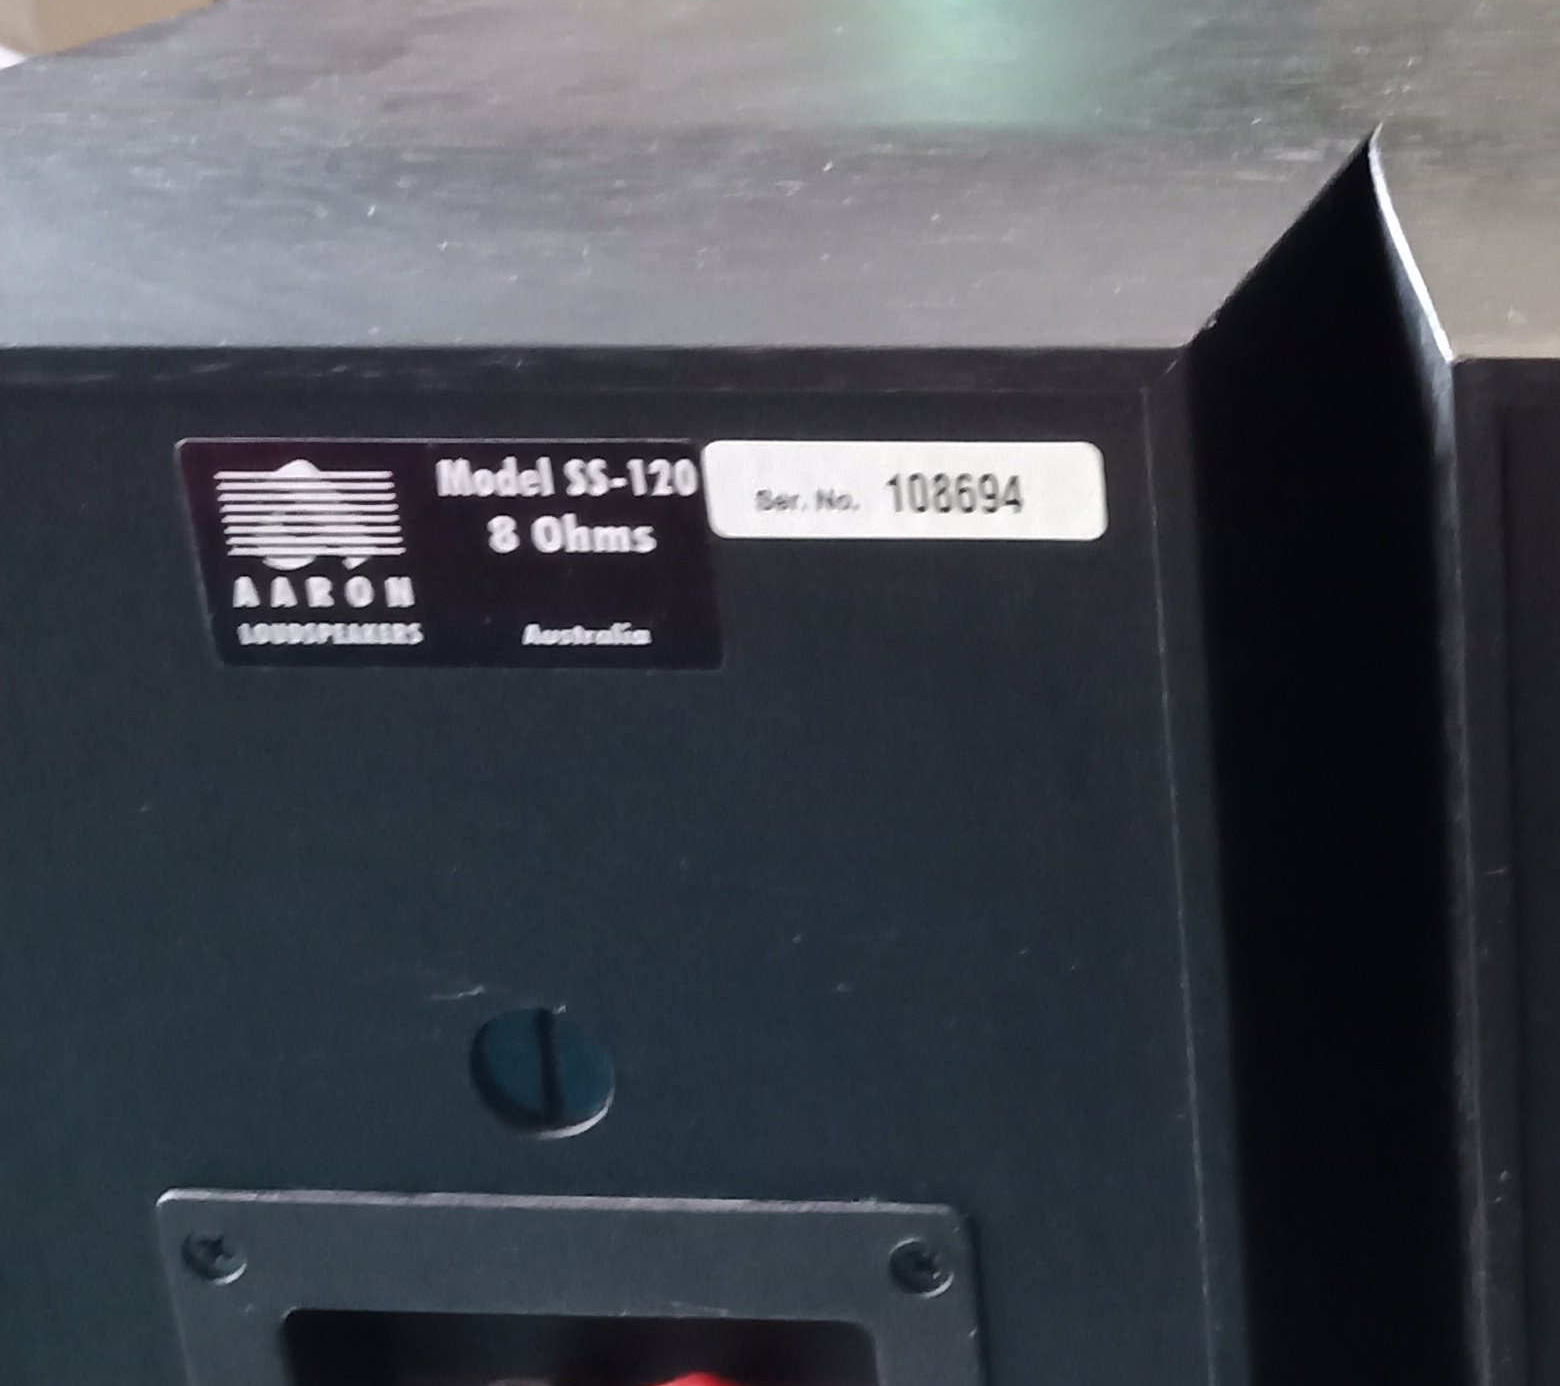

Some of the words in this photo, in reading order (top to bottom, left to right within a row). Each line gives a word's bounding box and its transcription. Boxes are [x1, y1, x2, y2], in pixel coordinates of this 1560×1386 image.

[436, 456, 555, 497] Model
[563, 458, 699, 497] SS-120
[816, 487, 860, 512] No.
[886, 472, 1024, 515] 108694
[487, 515, 520, 553] 8
[531, 513, 657, 553] Ohms
[232, 575, 415, 608] AARON
[236, 622, 424, 646] LOUDSPEAKERS
[521, 622, 652, 646] Australia
